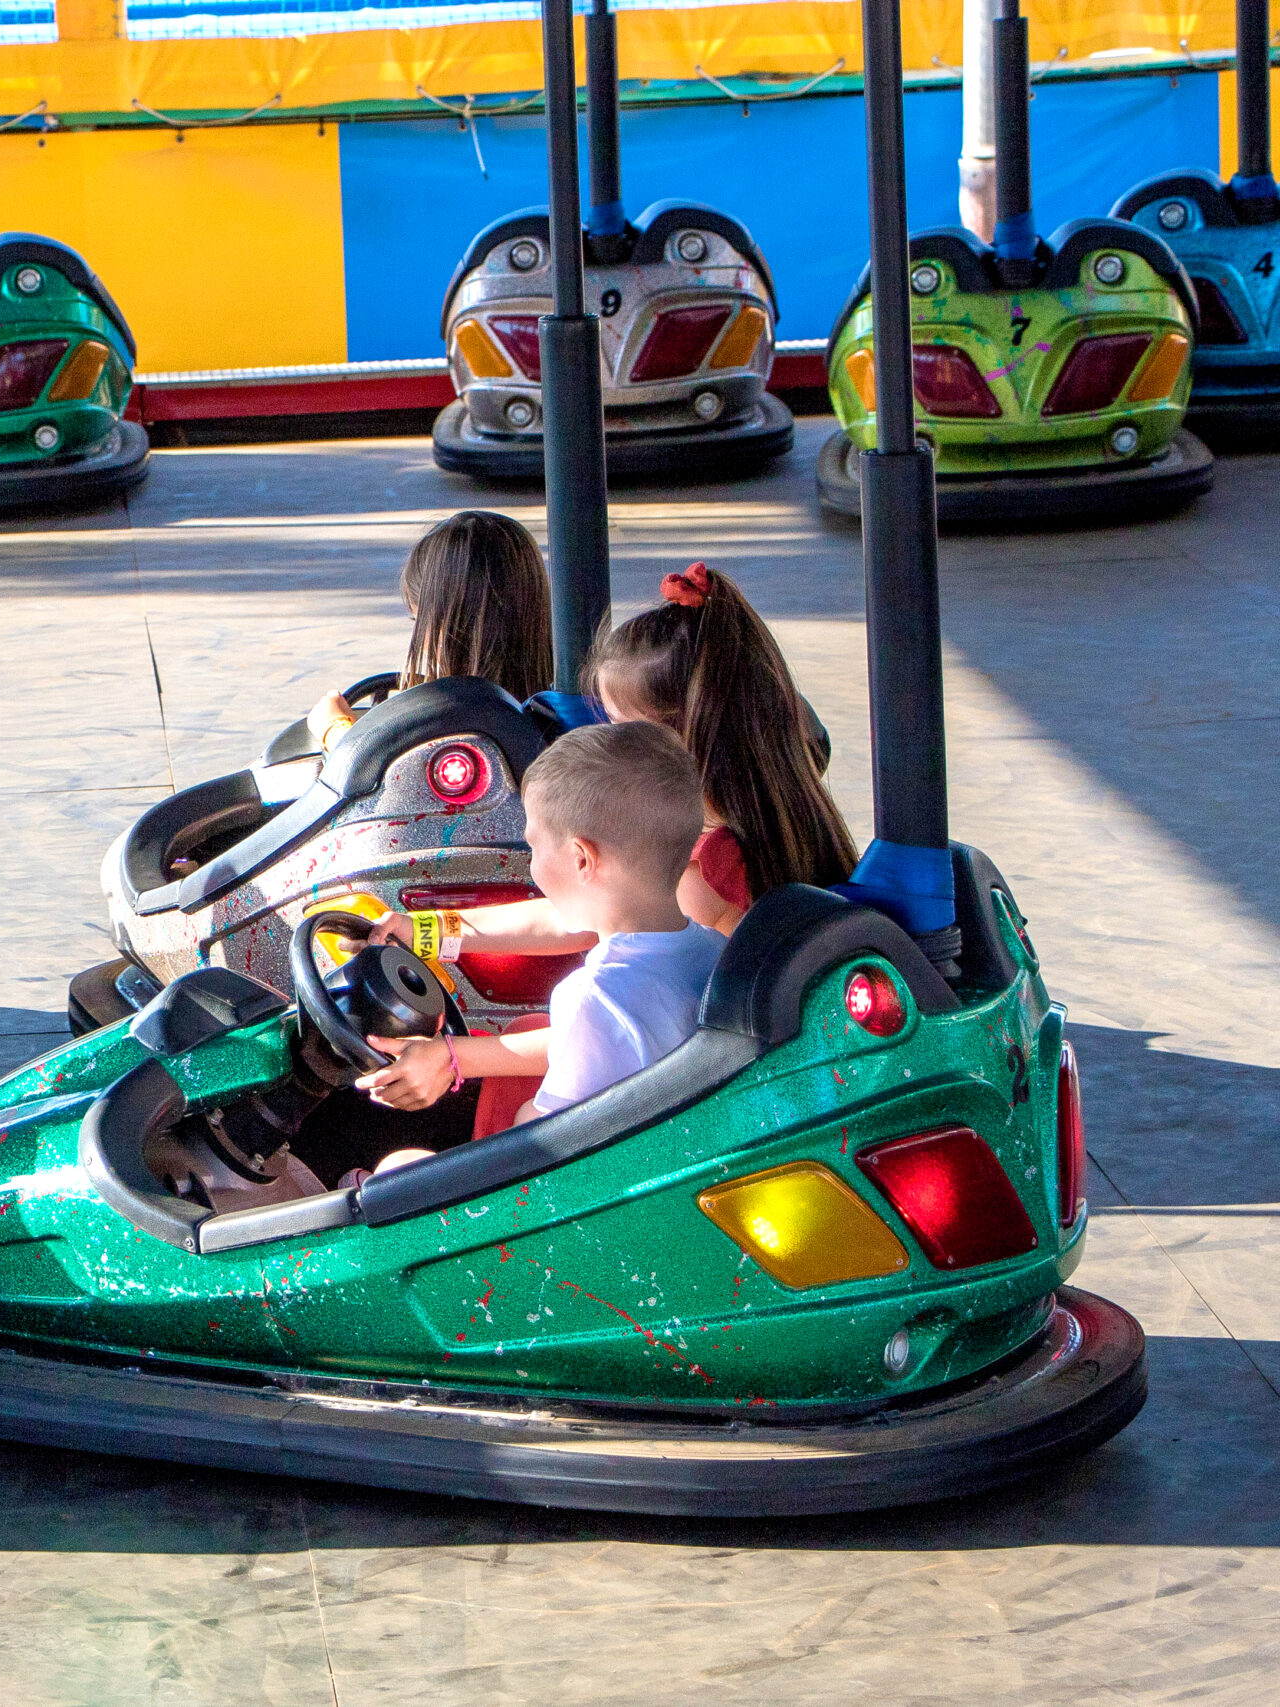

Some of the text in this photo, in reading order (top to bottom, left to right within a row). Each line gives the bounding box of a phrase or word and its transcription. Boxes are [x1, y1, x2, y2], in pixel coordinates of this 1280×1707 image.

[1253, 251, 1275, 278] 4
[601, 289, 622, 318] 9
[1011, 317, 1032, 346] 7
[1007, 1044, 1029, 1107] 2
